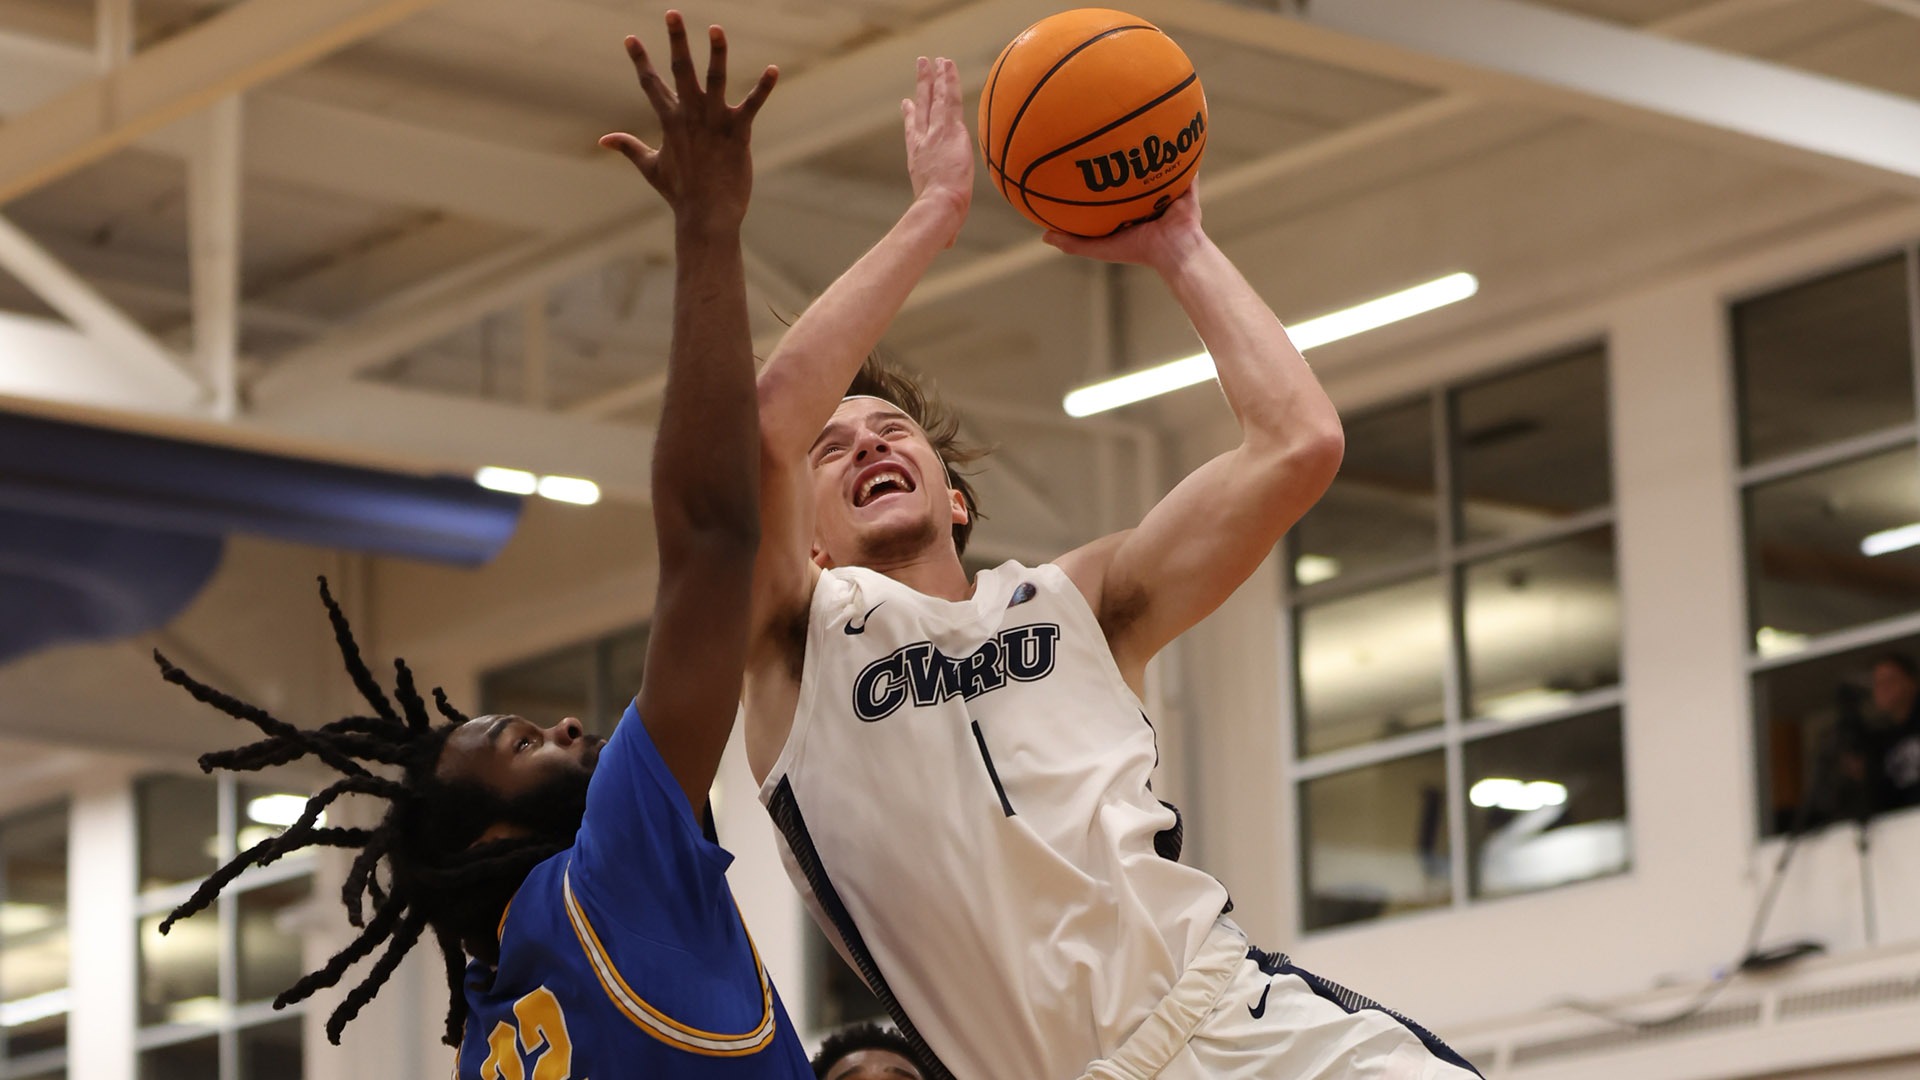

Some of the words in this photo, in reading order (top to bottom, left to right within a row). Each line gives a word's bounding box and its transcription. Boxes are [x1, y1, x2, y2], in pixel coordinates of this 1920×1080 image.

[1075, 111, 1205, 192] Wilson
[1143, 172, 1163, 185] EVO
[853, 623, 1060, 722] CWRU
